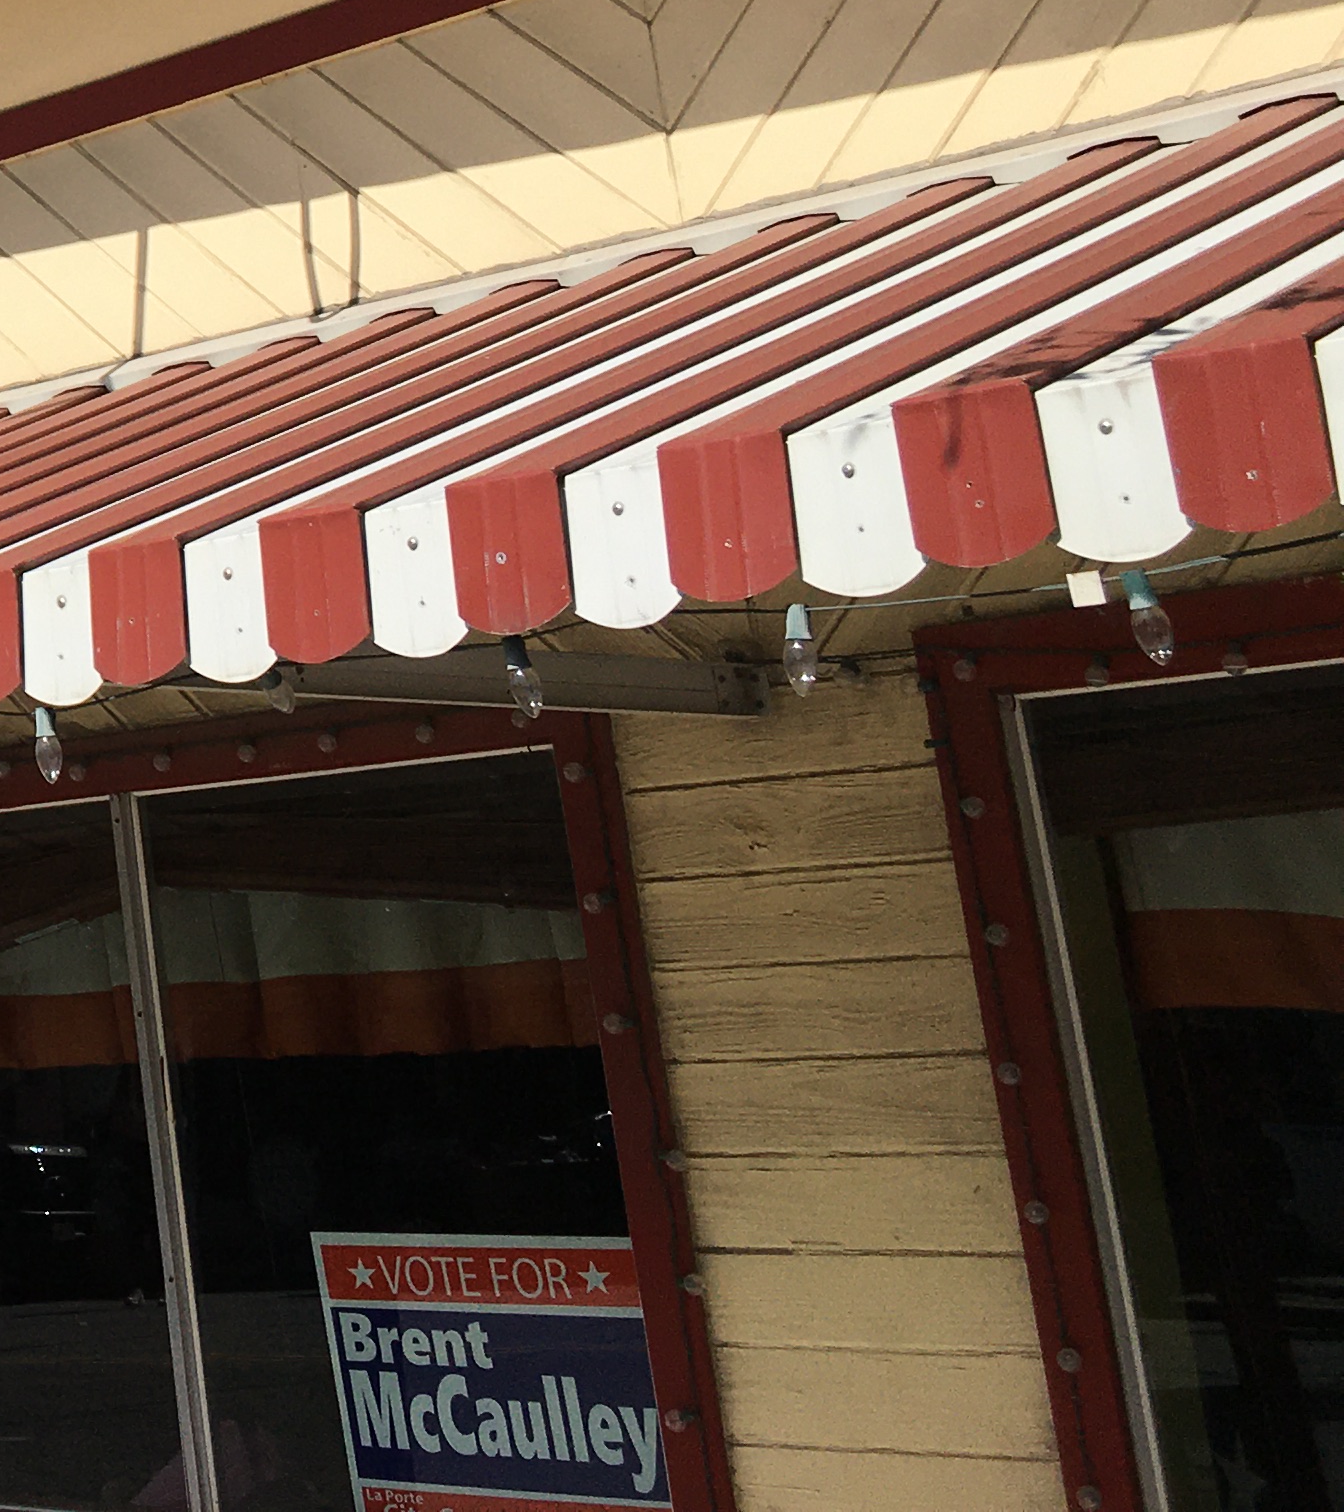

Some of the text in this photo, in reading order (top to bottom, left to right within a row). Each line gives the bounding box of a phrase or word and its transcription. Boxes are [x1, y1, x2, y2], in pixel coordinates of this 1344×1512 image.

[377, 1256, 573, 1300] VOTE FOR
[338, 1311, 494, 1370] Brent
[349, 1368, 658, 1494] McCaulley
[365, 1488, 424, 1504] La Porte
